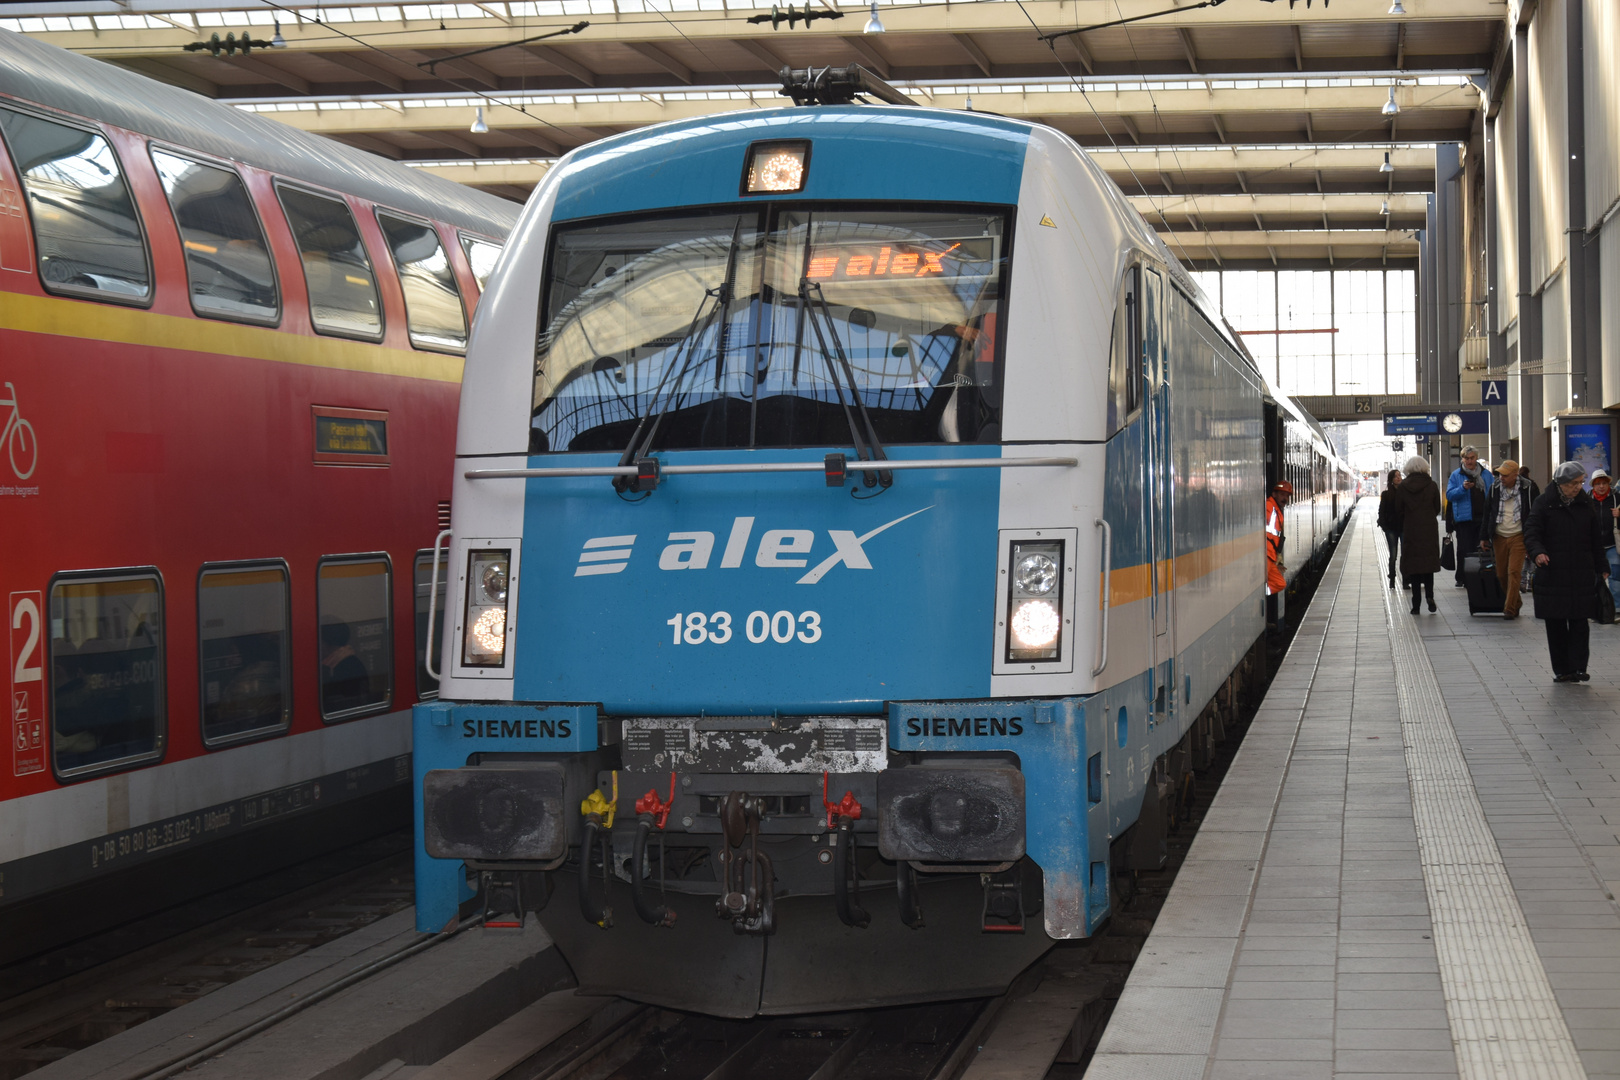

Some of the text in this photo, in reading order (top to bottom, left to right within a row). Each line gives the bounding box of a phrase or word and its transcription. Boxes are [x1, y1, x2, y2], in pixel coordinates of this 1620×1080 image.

[846, 242, 961, 277] alex
[1485, 381, 1501, 400] A
[1357, 402, 1371, 413] 26
[1393, 441, 1401, 450] C
[658, 504, 934, 586] alex
[12, 598, 42, 683] 2
[667, 610, 823, 645] 183 003
[462, 719, 572, 739] SIEMENS
[906, 716, 1024, 737] SIEMENS
[92, 840, 116, 867] D-DB
[119, 835, 131, 856] 50
[132, 831, 145, 852] 80
[146, 823, 173, 849] 86-35
